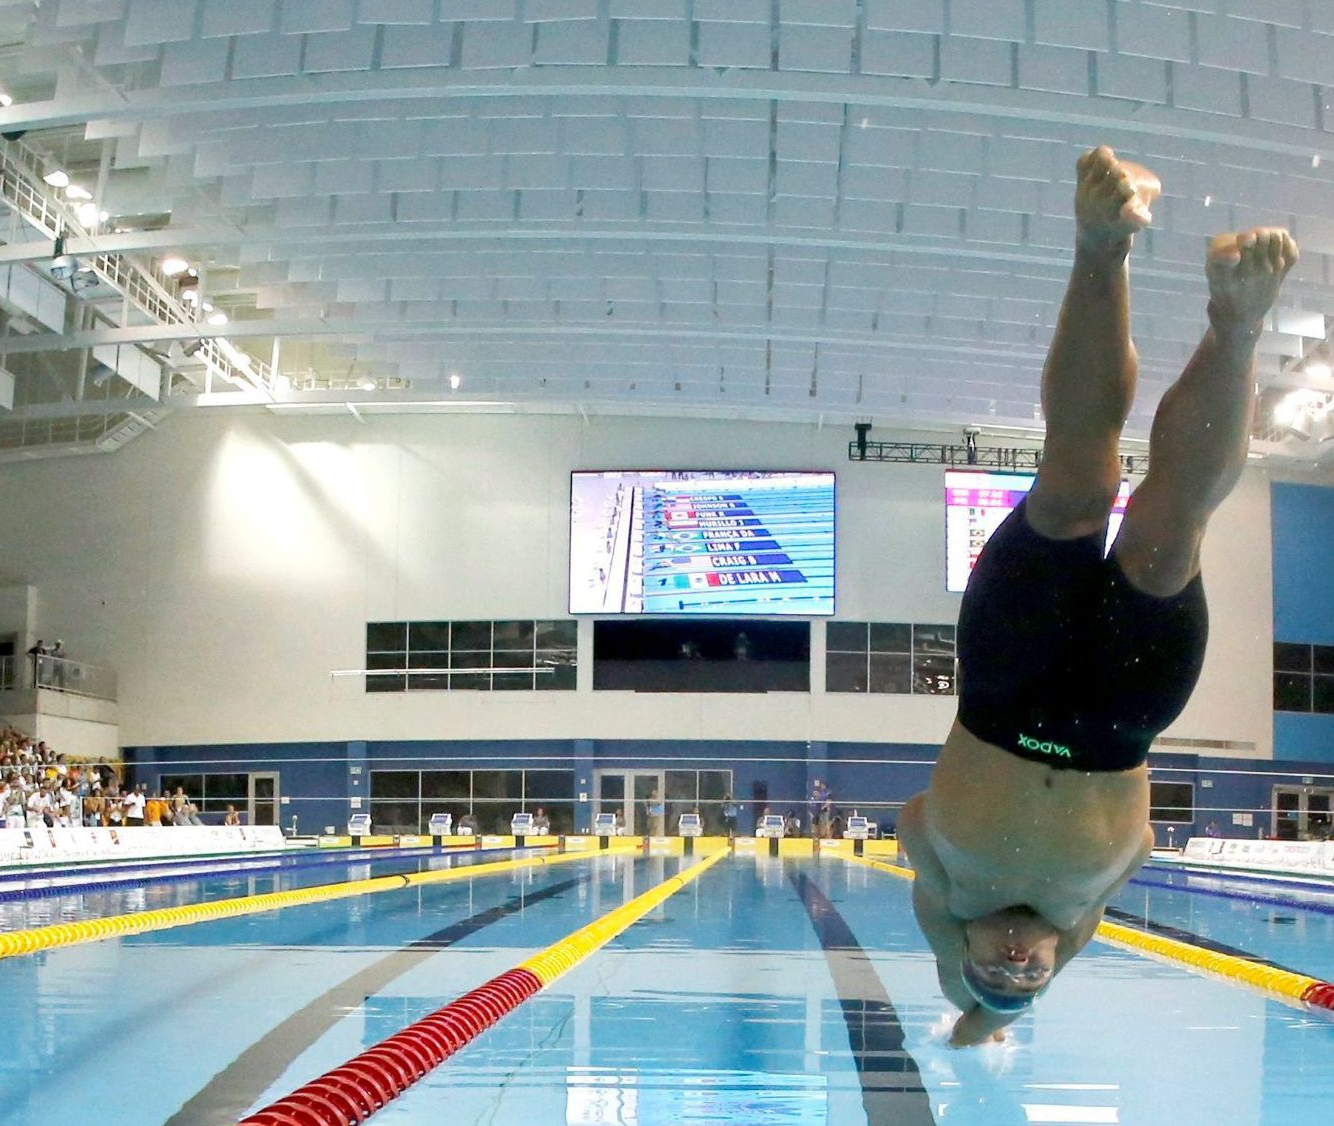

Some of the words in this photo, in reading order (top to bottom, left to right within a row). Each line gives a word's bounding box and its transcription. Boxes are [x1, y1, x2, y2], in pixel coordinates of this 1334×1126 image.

[740, 529, 755, 537] DA
[707, 543, 734, 551] LIMA
[712, 556, 747, 567] CRAIG
[718, 572, 735, 585] DE
[736, 571, 769, 583] LARA
[769, 572, 781, 582] M
